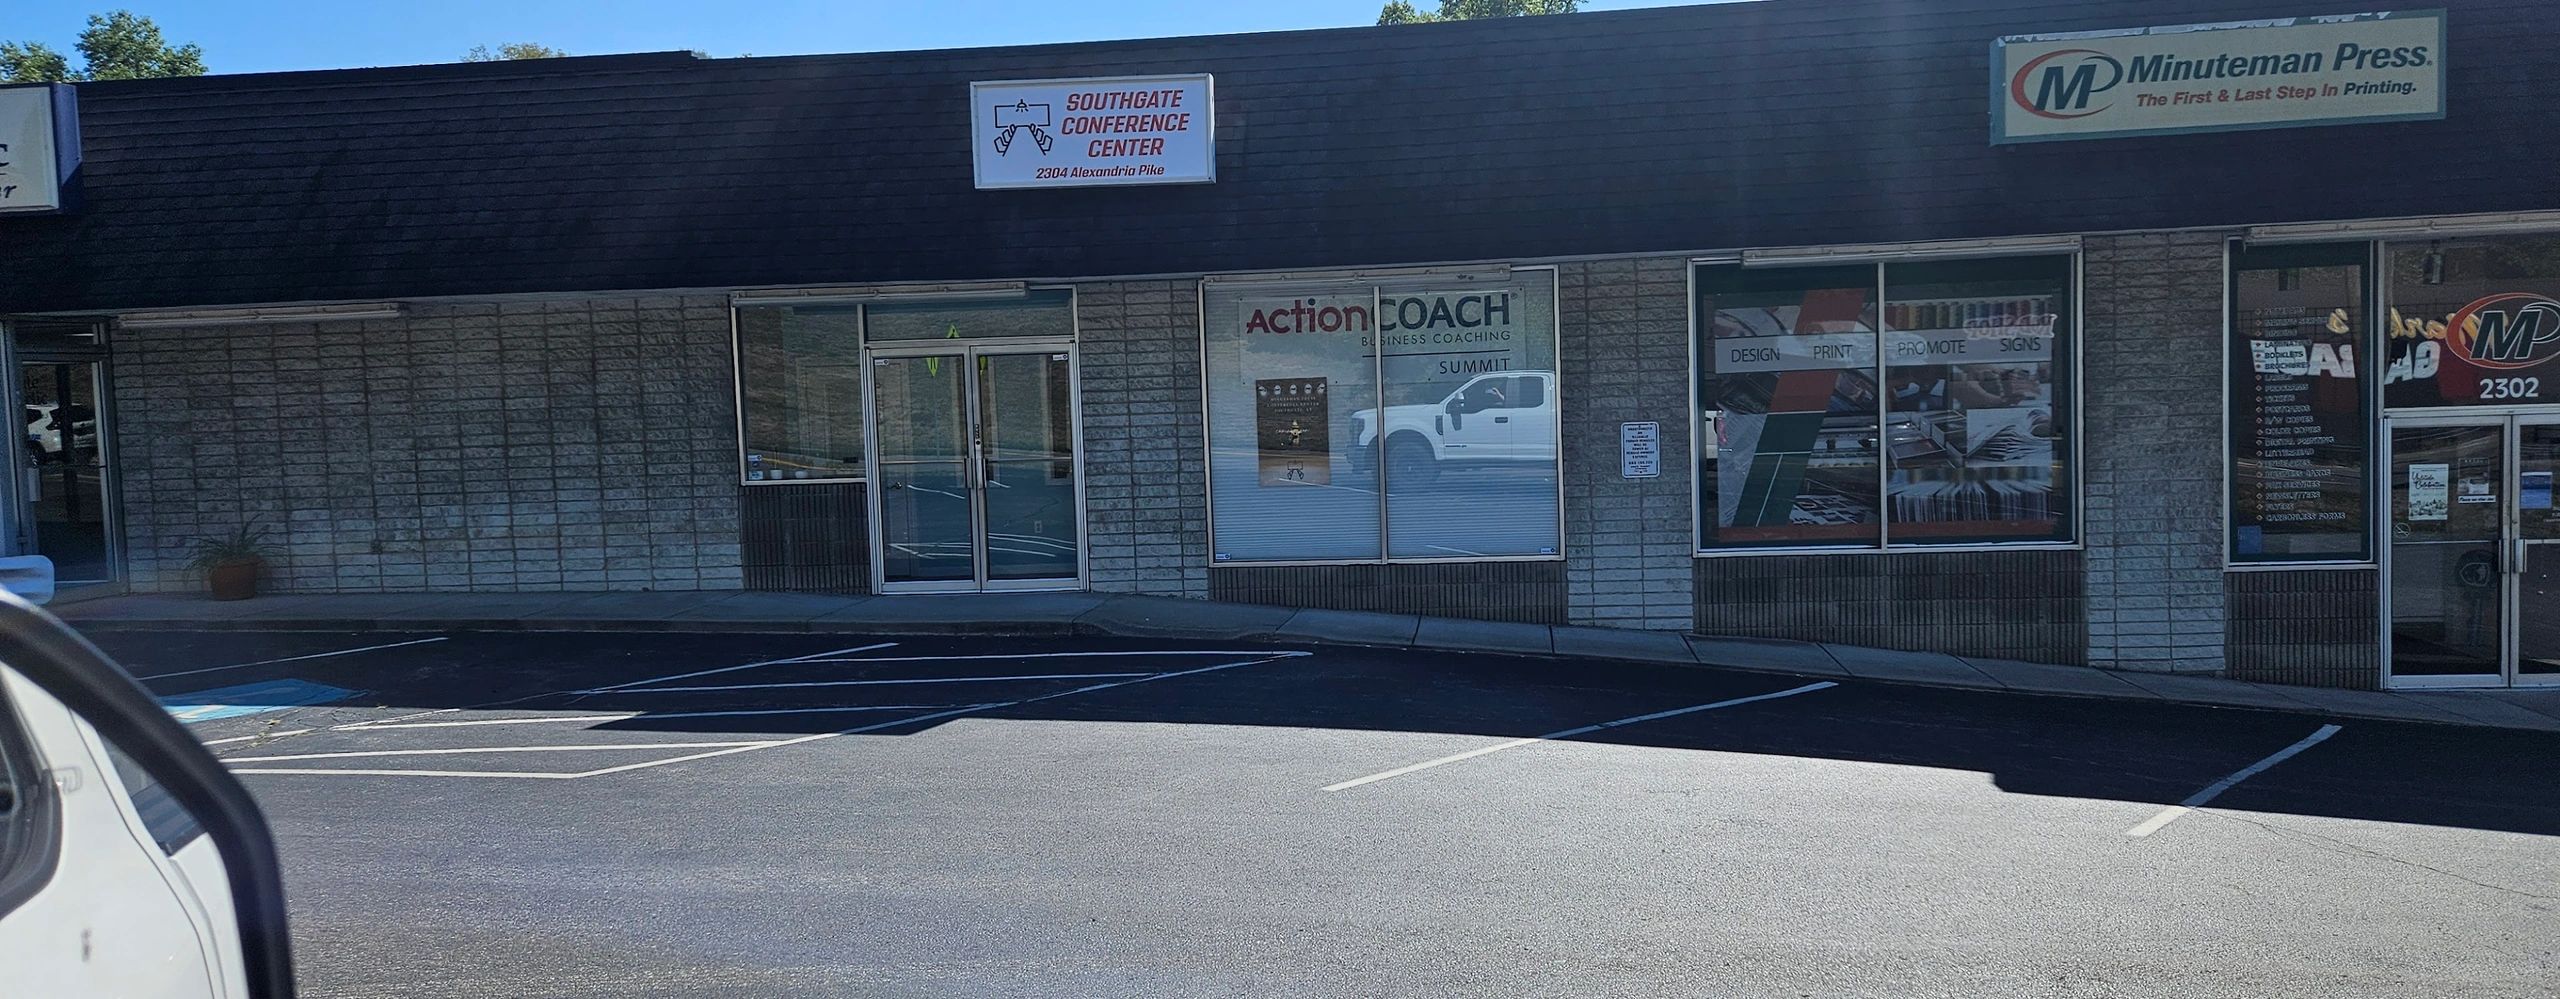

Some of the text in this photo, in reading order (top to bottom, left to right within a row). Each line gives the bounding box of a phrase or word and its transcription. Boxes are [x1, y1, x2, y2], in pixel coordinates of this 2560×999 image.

[2127, 51, 2323, 84] Minuteman
[1066, 90, 1184, 111] SOUTHGATE
[2136, 80, 2417, 107] The First & Last Step In Printing.
[1061, 113, 1190, 135] CONFERENCE
[1088, 138, 1165, 158] CENTER
[1036, 164, 1164, 179] 2304 Alexandria Pike
[1361, 330, 1511, 347] BUSINESS COACHING
[1731, 336, 2042, 364] DESIGN PRINT PROMOTE SIGNS
[2264, 350, 2304, 359] BOOKLETS
[1439, 358, 1511, 375] SUMMIT
[2264, 361, 2311, 370] BROCHURES
[2479, 376, 2540, 400] 2302
[2265, 425, 2321, 435] COLOR COPIES
